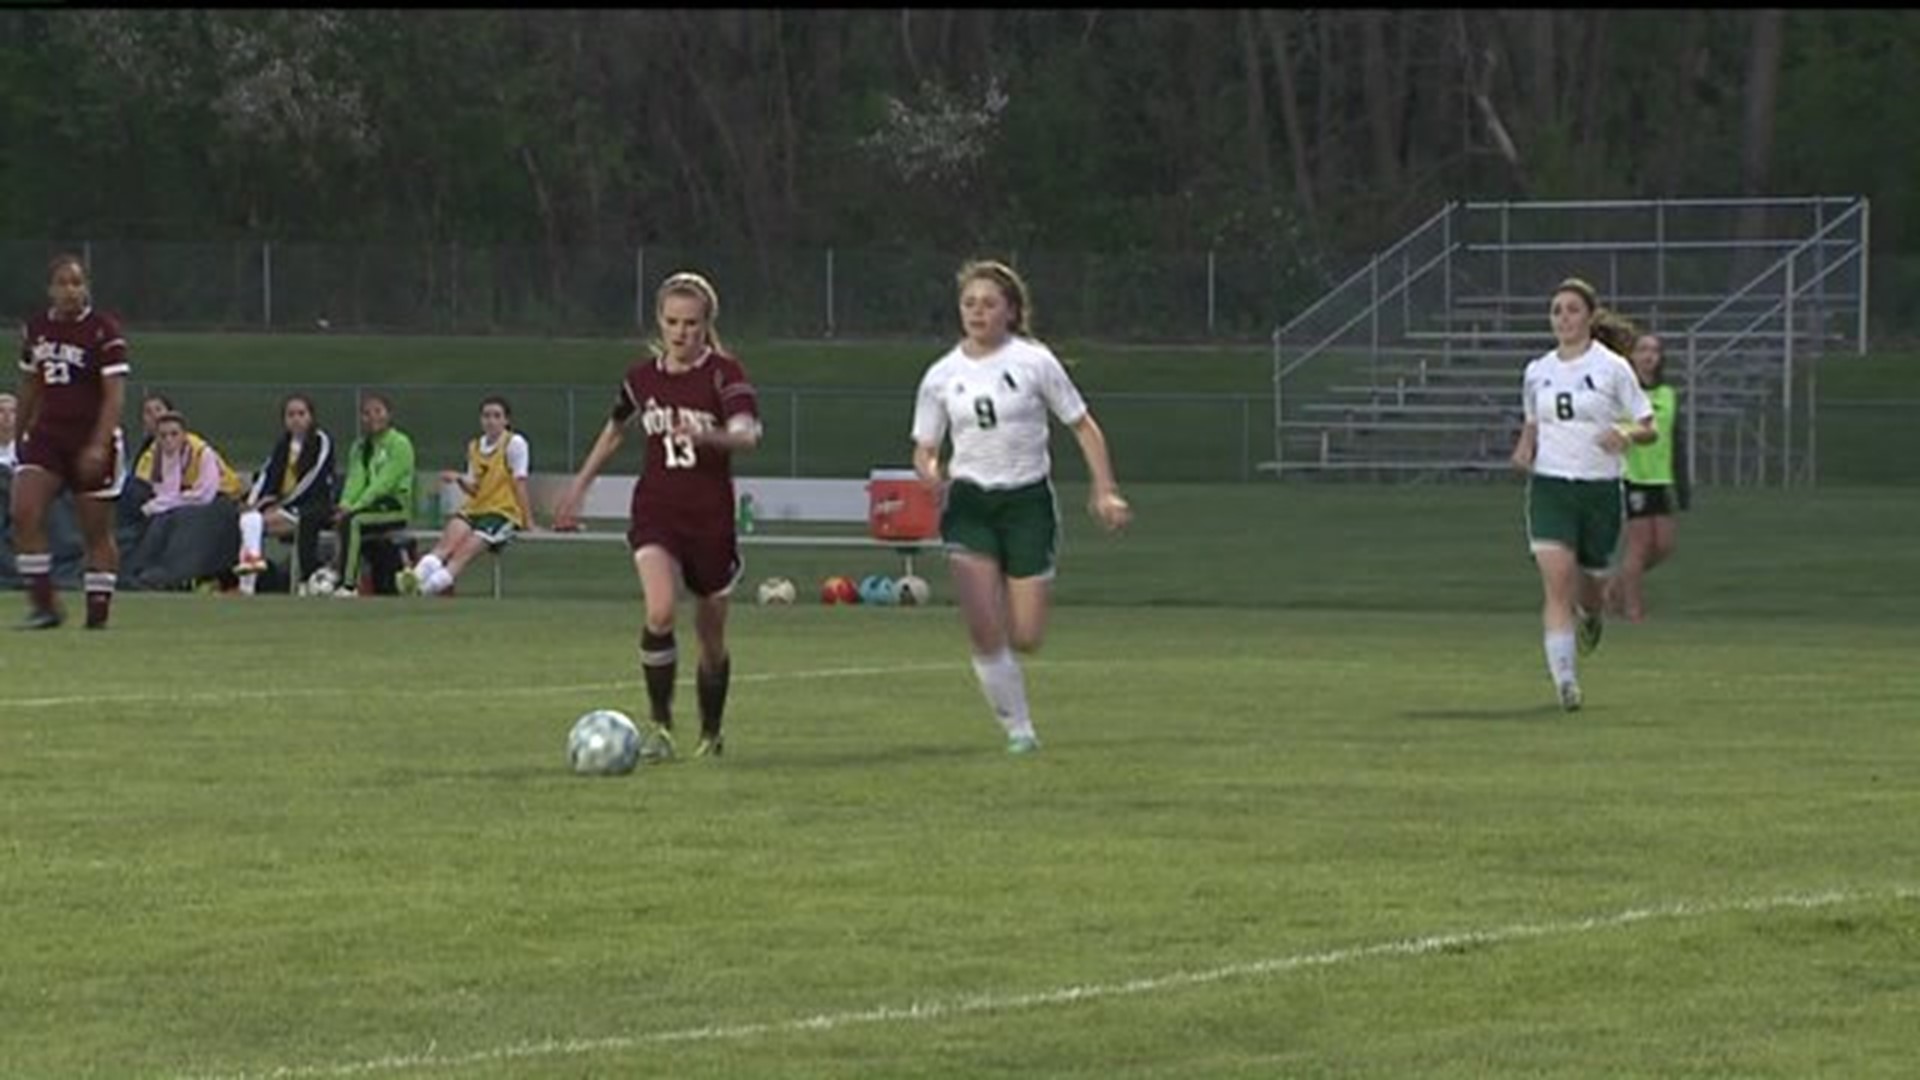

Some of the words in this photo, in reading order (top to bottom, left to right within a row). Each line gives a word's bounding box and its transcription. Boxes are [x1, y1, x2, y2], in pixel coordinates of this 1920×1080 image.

[43, 360, 70, 384] 23
[974, 396, 997, 428] 9
[663, 435, 696, 468] 13
